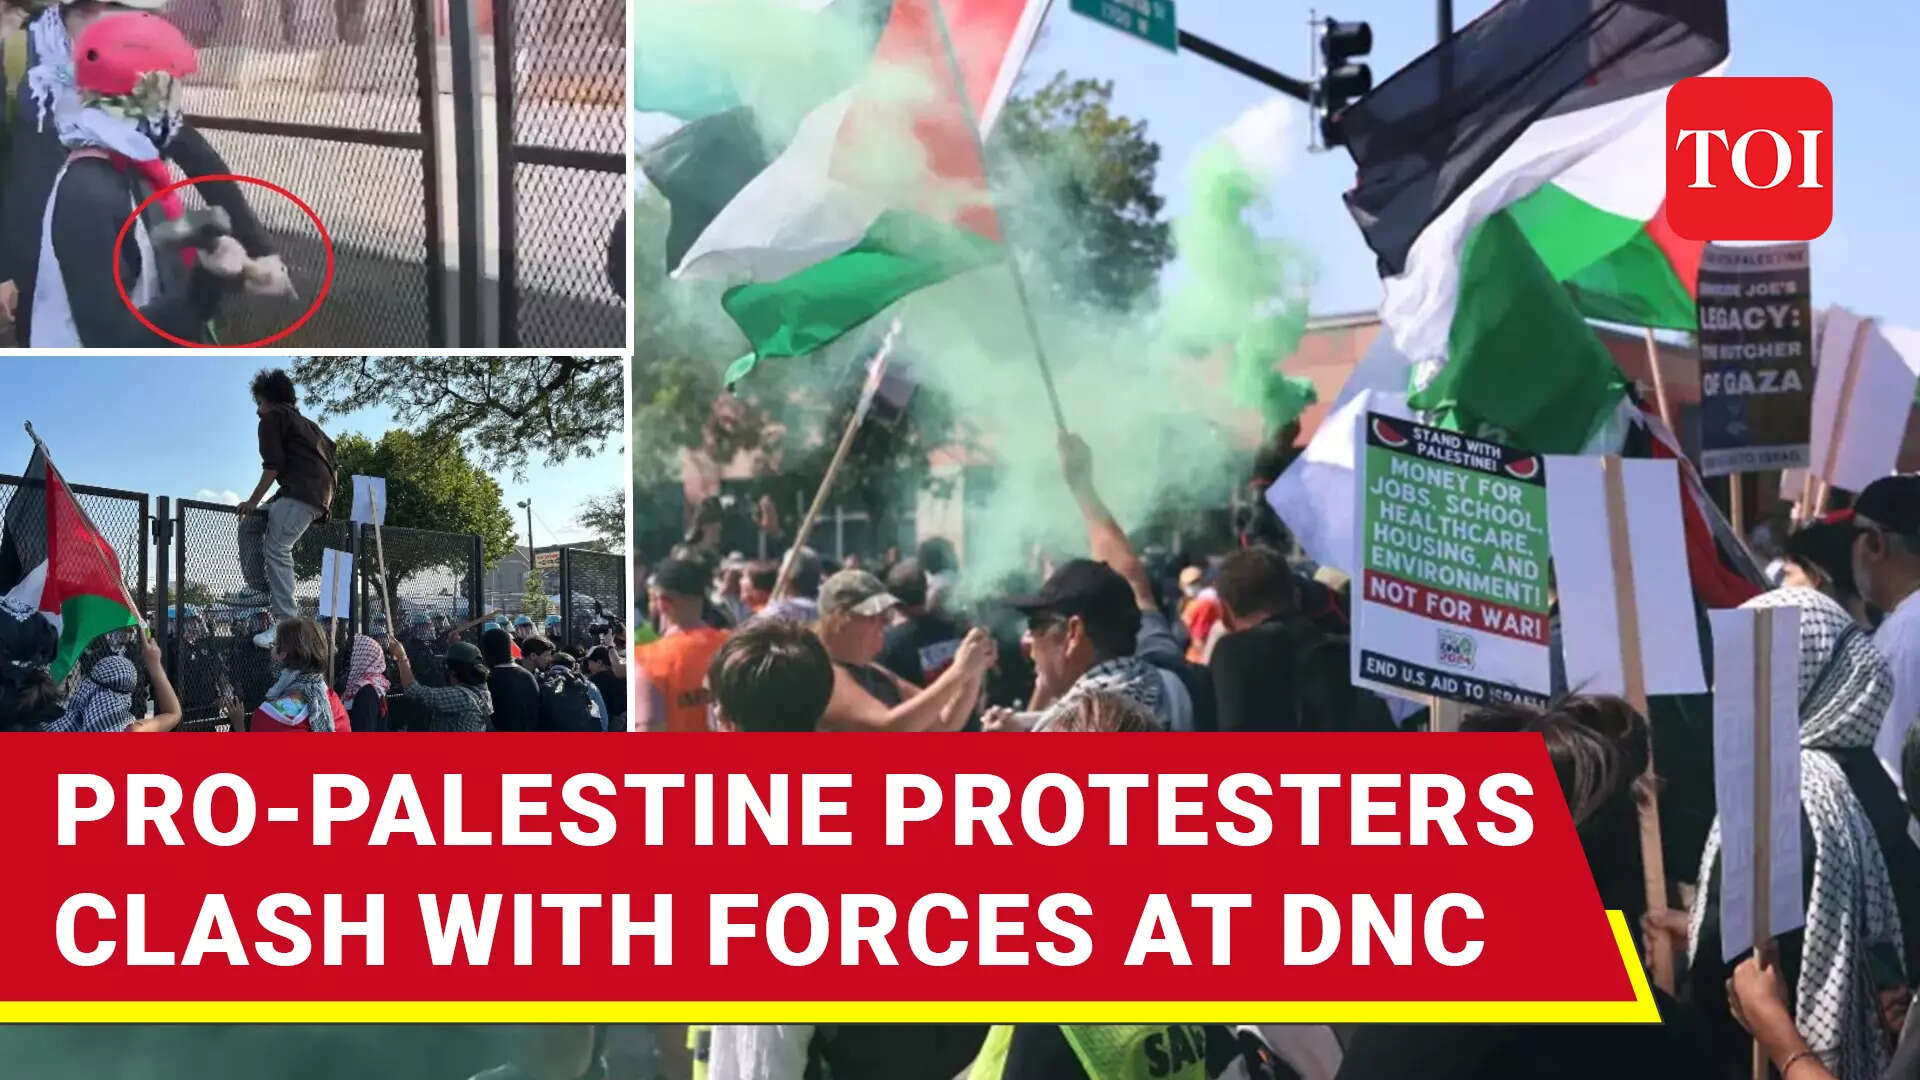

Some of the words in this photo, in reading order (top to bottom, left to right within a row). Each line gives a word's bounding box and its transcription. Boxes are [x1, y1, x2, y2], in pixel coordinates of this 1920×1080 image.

[1744, 281, 1797, 297] JOE'S
[1701, 304, 1801, 331] LEGACY:
[1703, 372, 1720, 396] OF
[1723, 368, 1803, 395] GAZA
[1413, 427, 1461, 449] STAND
[1466, 440, 1501, 459] WITH
[1417, 443, 1497, 471] PALESTINE!
[1391, 456, 1469, 494] MONEY
[1479, 478, 1522, 505] FOR
[1371, 546, 1540, 606] ENVIRONMENT!
[1490, 555, 1539, 580] AND
[1371, 577, 1417, 608] NOT
[1426, 592, 1472, 622] FOR
[1480, 606, 1542, 639] WAR!
[1366, 657, 1396, 678] END
[1402, 667, 1426, 686] U.S
[1430, 676, 1458, 694] AID
[1463, 682, 1484, 700] TO
